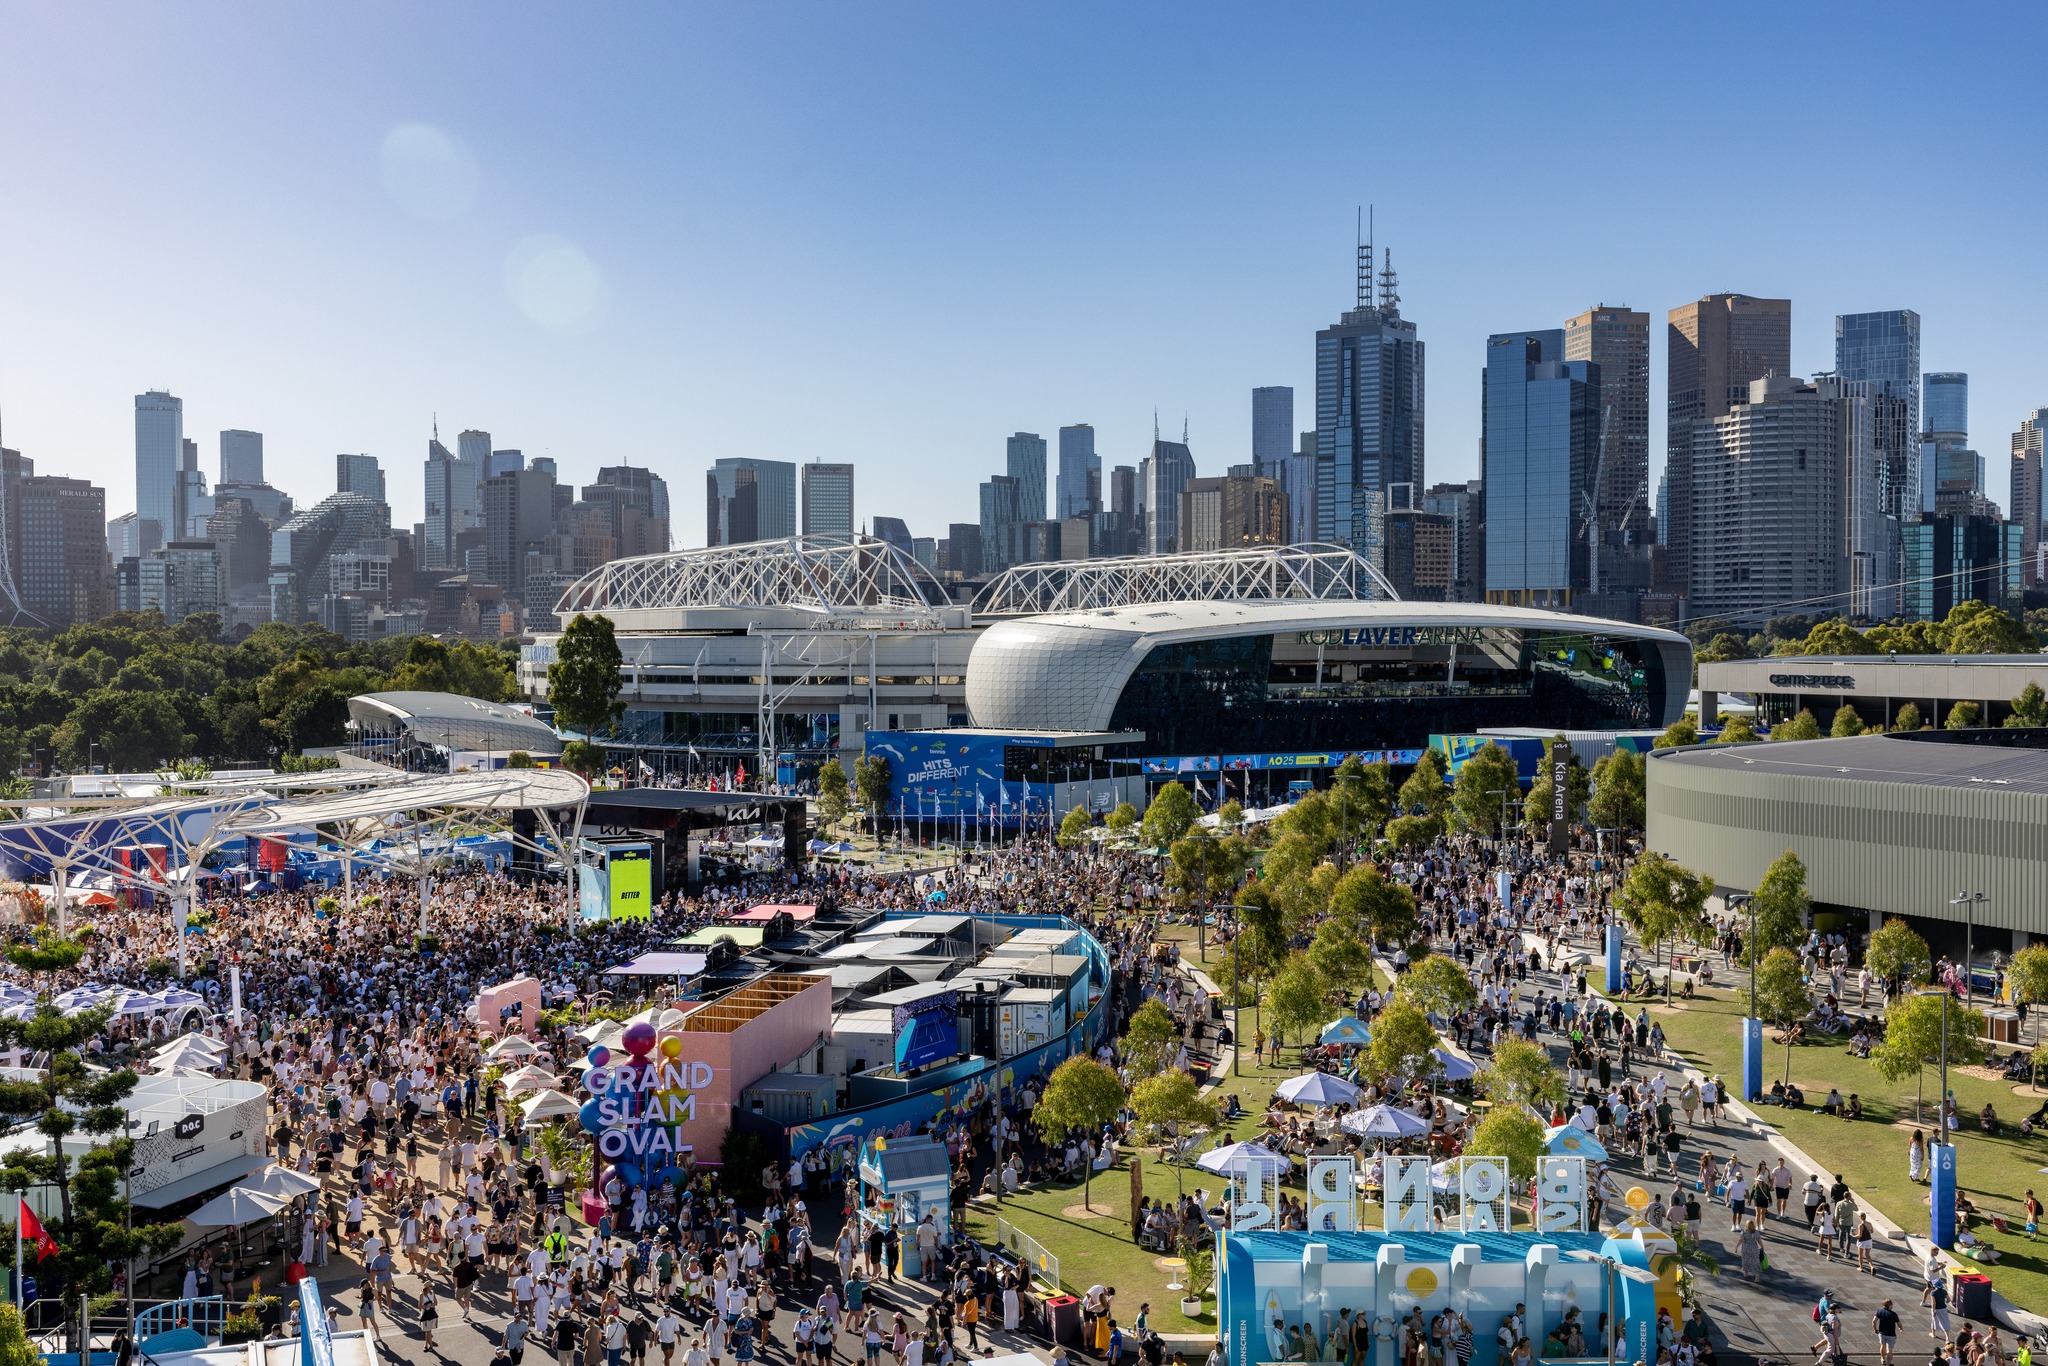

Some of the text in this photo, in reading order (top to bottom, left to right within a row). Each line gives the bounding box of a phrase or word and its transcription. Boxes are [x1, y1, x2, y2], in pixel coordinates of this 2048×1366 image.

[1298, 625, 1484, 646] ROD LAVER ARENA
[922, 758, 952, 771] HITS
[1268, 755, 1294, 765] AO25
[907, 765, 970, 783] DIFFERENT
[1555, 762, 1566, 820] Kia Arena
[621, 891, 640, 900] BETTER
[584, 1062, 714, 1095] GRAND
[597, 1094, 696, 1126] SLAM
[182, 1120, 200, 1133] D.O.C
[600, 1126, 693, 1157] OVAL
